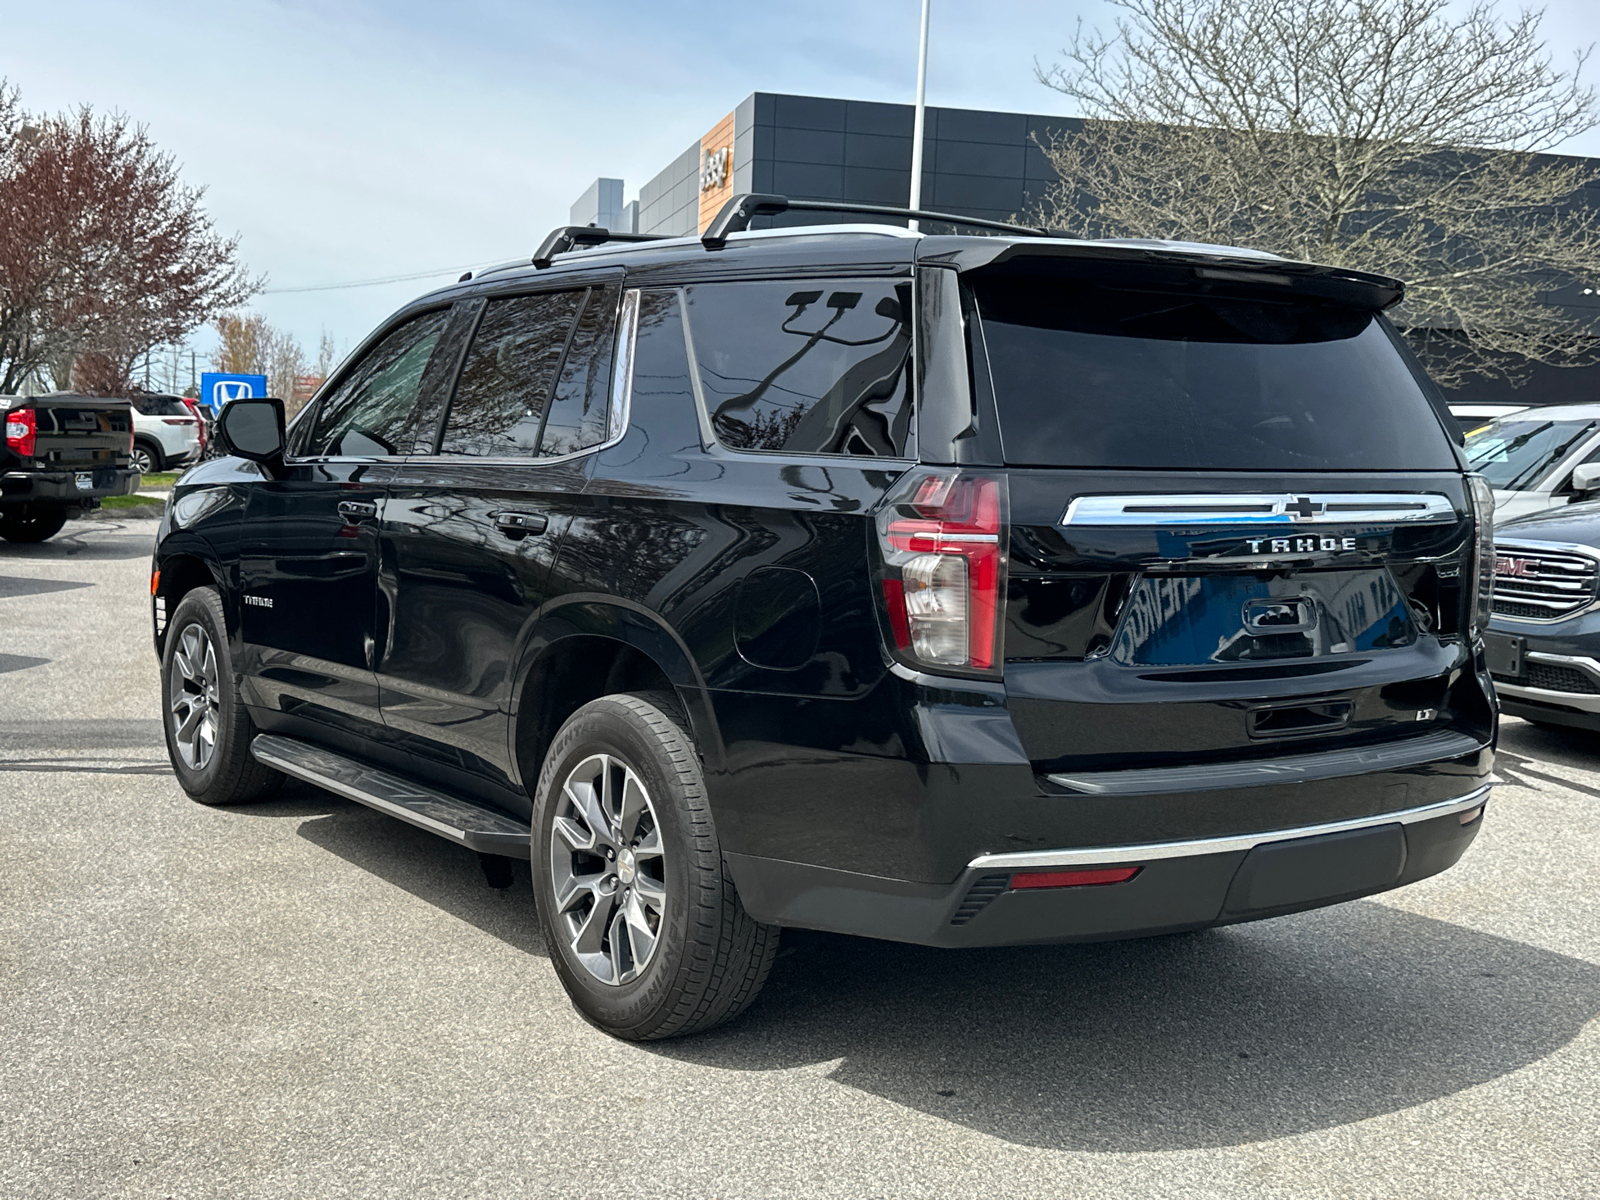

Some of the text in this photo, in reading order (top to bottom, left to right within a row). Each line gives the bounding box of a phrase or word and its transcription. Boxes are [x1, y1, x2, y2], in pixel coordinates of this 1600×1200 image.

[1246, 538, 1356, 554] TAHOE
[1493, 557, 1541, 578] GMC
[1416, 708, 1434, 721] LT
